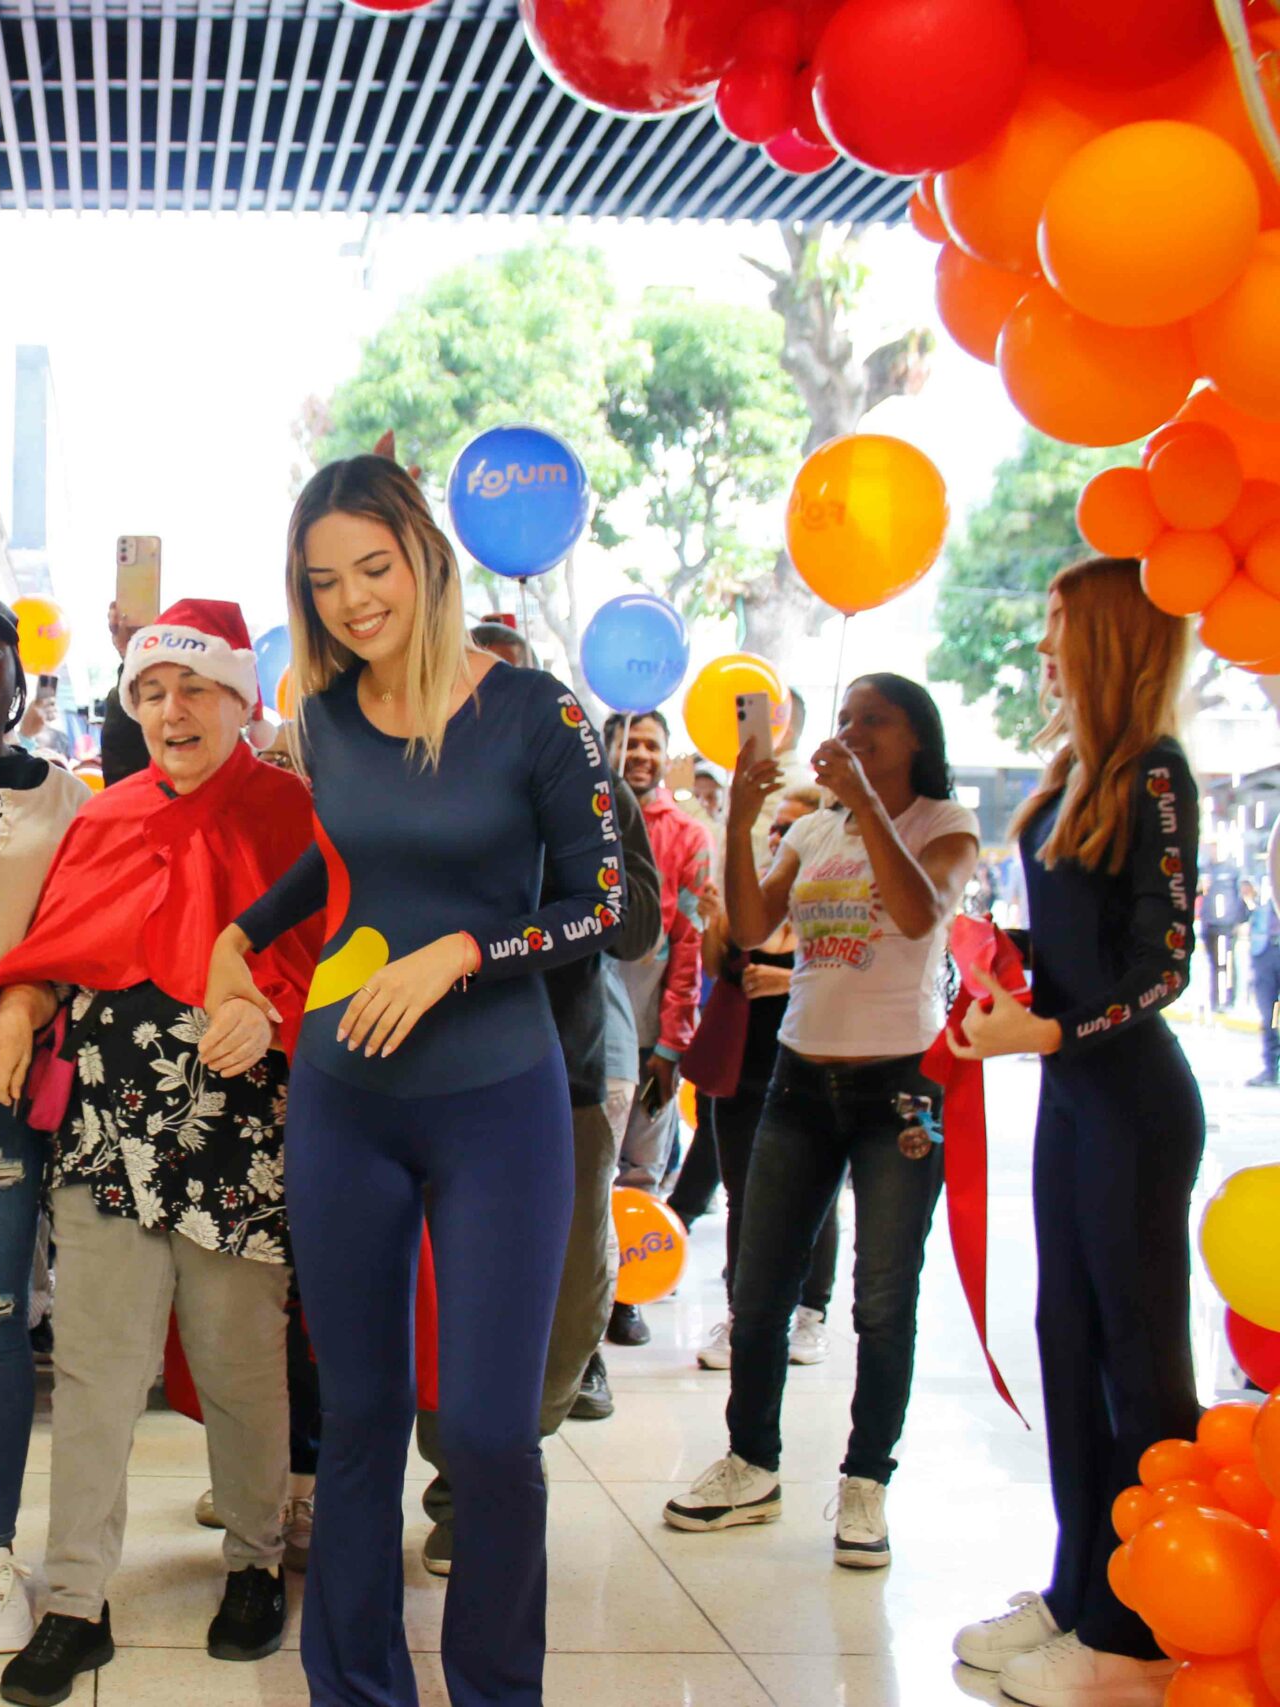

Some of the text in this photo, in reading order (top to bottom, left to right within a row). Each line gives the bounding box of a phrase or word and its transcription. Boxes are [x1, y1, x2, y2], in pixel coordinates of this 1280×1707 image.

[467, 462, 567, 498] Forum
[135, 632, 207, 652] Forum
[558, 693, 601, 767] Forum
[1147, 767, 1177, 833] Forum
[490, 927, 553, 960] Forum
[1076, 1004, 1131, 1039] Forum
